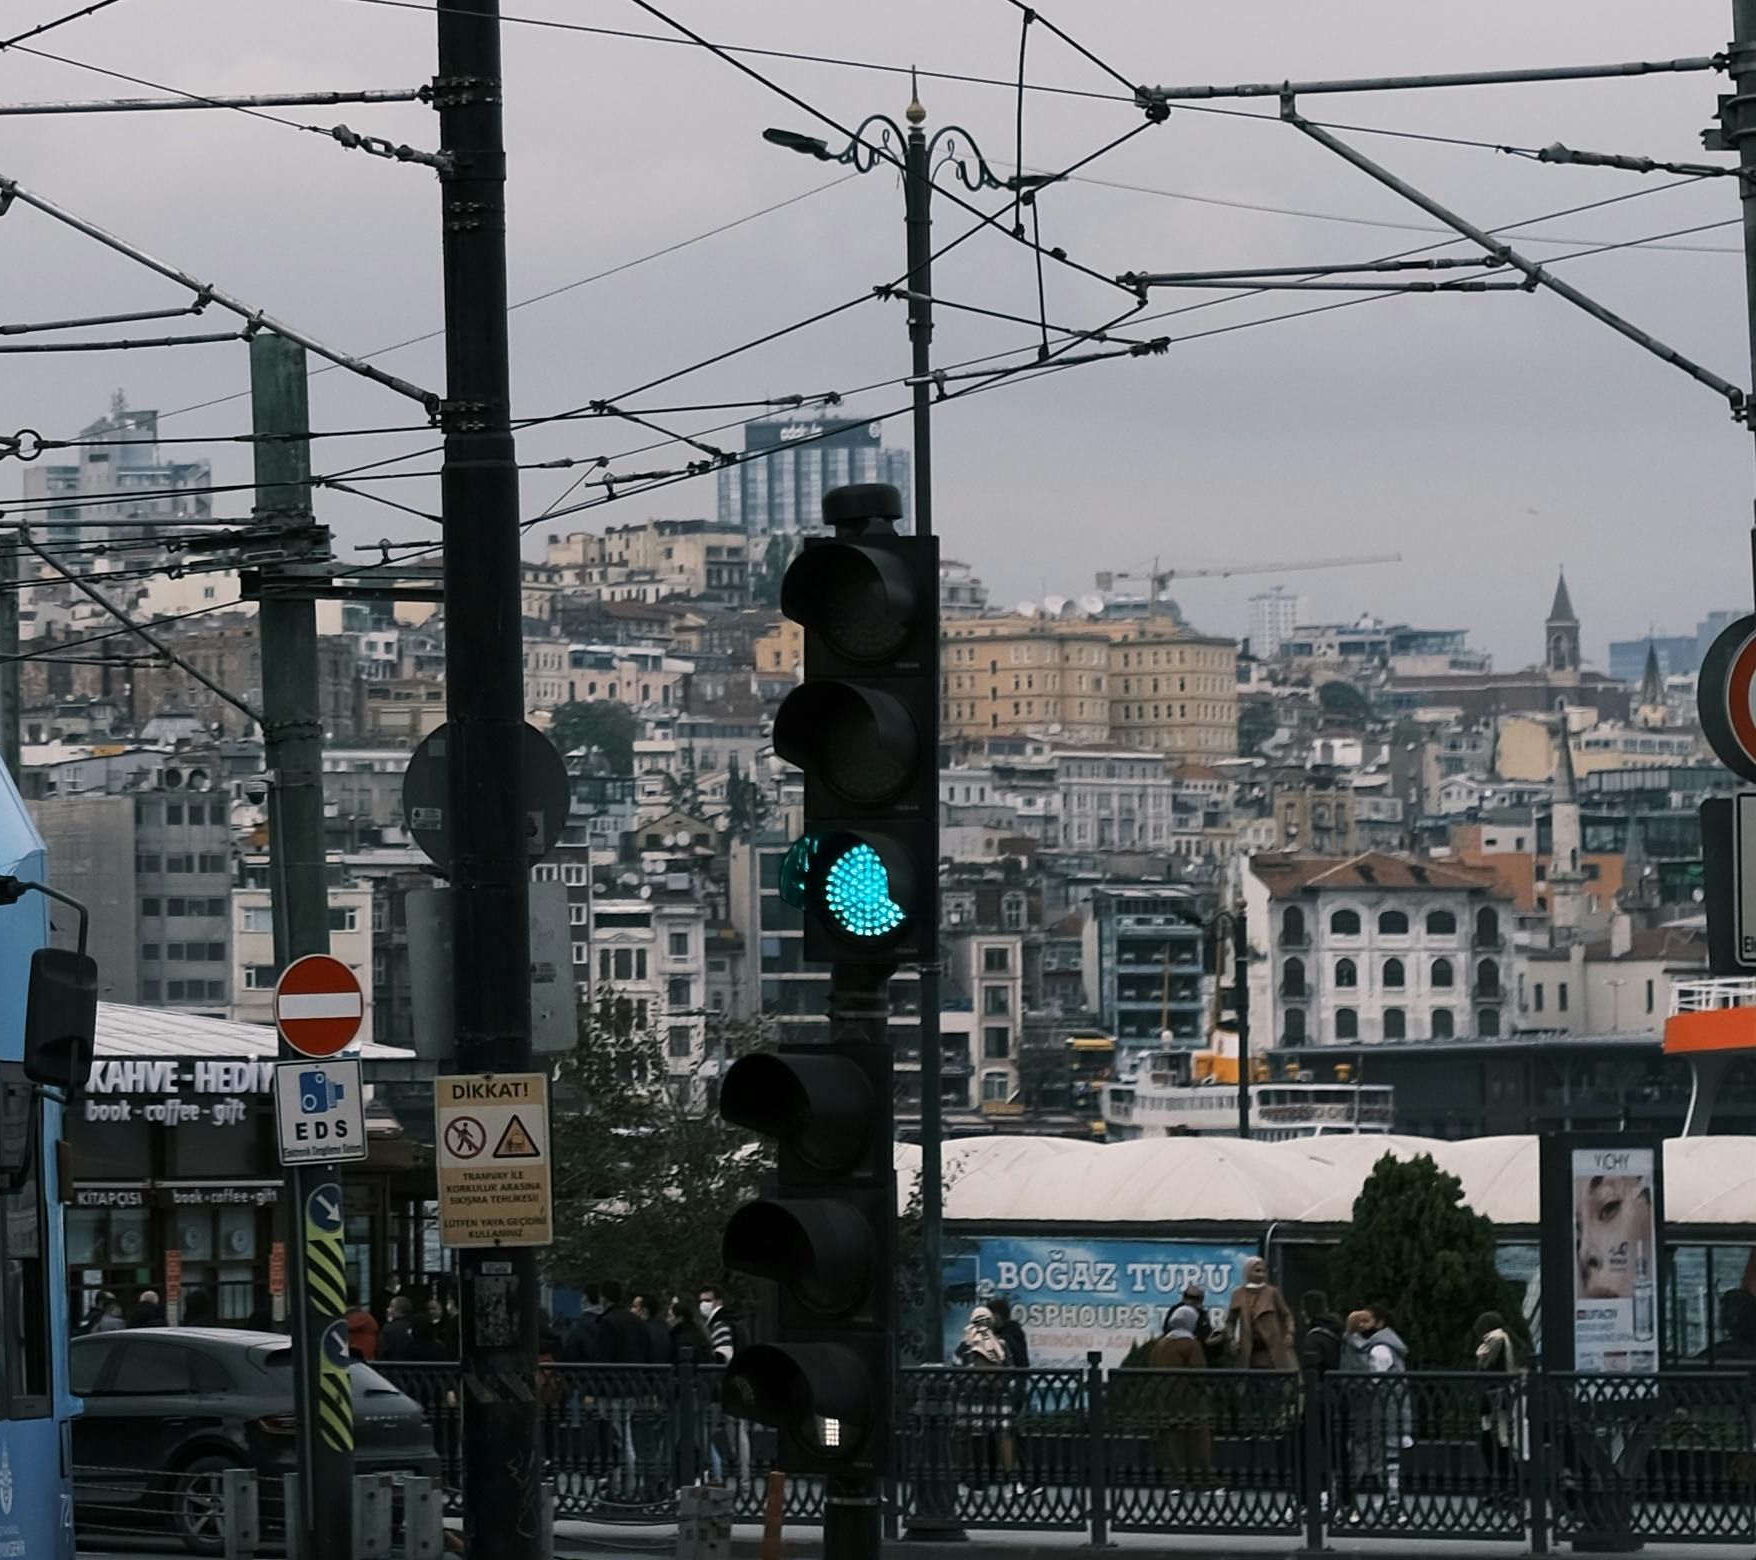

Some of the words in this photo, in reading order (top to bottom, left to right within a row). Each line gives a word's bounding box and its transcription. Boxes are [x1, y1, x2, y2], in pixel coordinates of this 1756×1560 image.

[85, 1061, 179, 1093] KAHVE
[195, 1053, 274, 1093] HEDİY
[452, 1081, 528, 1100] DİKKAT!
[85, 1099, 131, 1122] book
[145, 1098, 200, 1126] coffee
[212, 1097, 246, 1125] gift
[1595, 1154, 1630, 1170] VICHY
[480, 1217, 505, 1226] YAYA
[997, 1249, 1118, 1293] BOĞAZ
[1126, 1262, 1231, 1293] TURU
[1010, 1303, 1149, 1330] OSPHOURS
